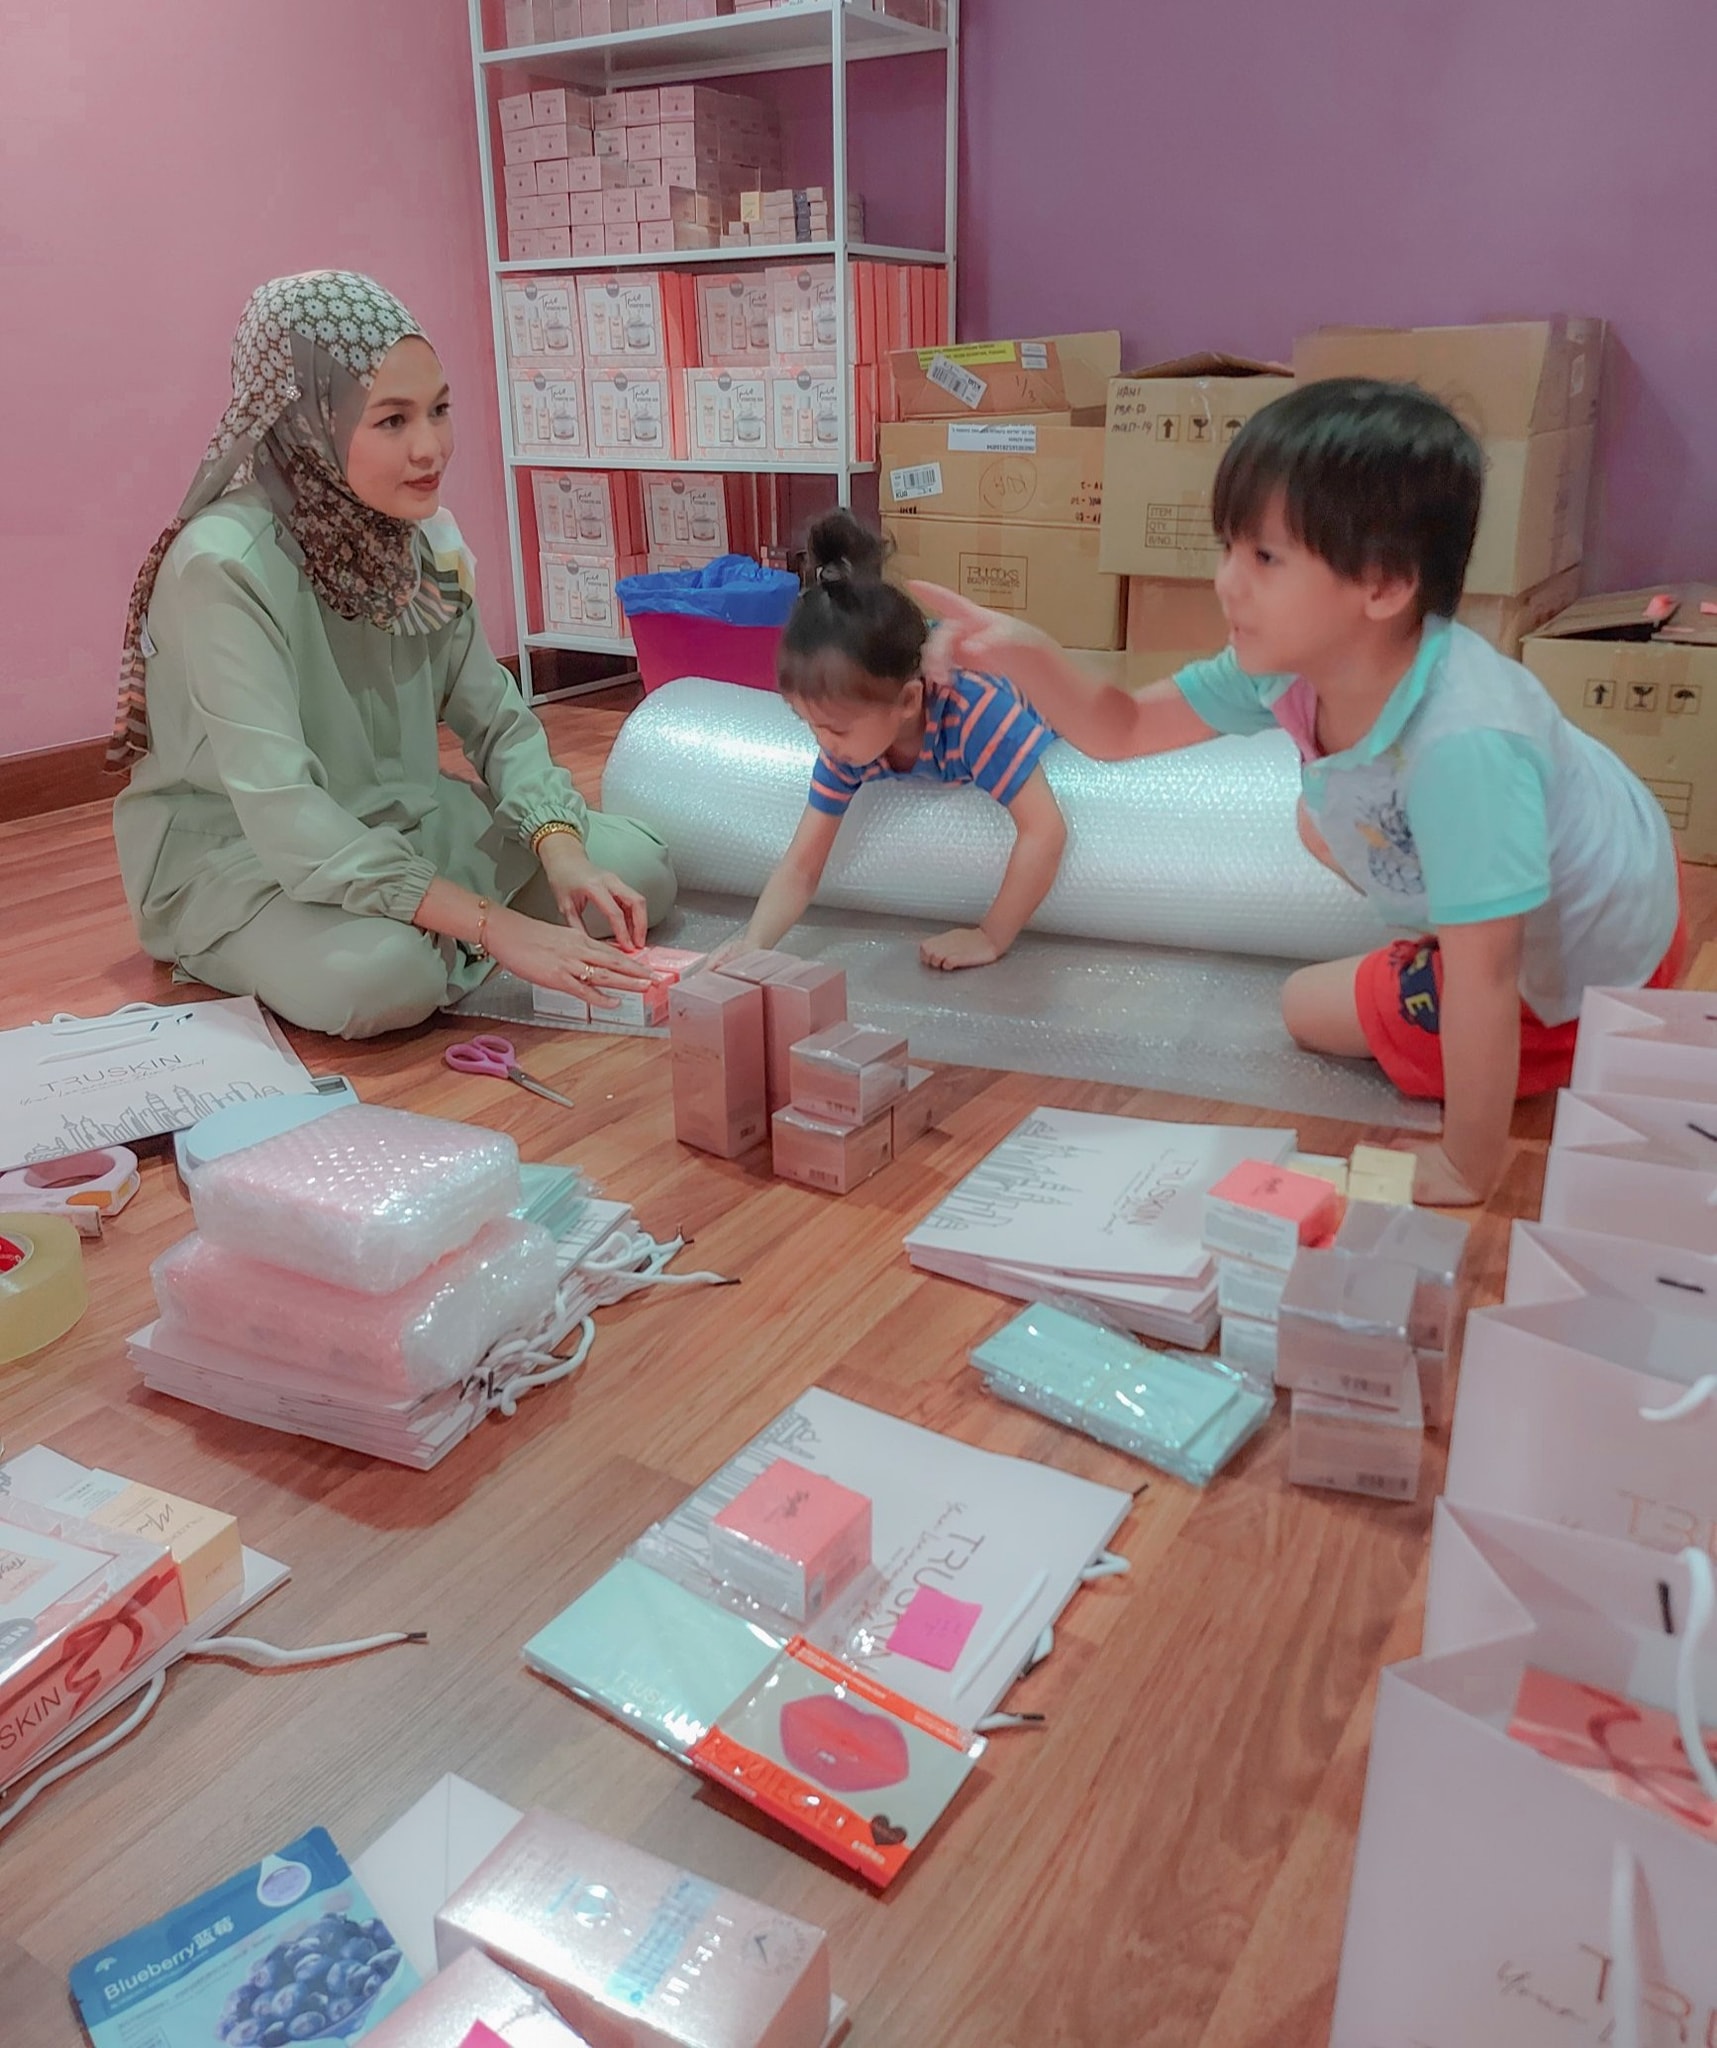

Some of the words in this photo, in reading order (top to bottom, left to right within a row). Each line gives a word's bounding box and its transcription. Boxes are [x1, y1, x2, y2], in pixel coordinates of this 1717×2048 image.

[1150, 507, 1172, 517] ITEM
[39, 1054, 183, 1093] TRUSKIN
[103, 1942, 196, 2002] Blueberry
